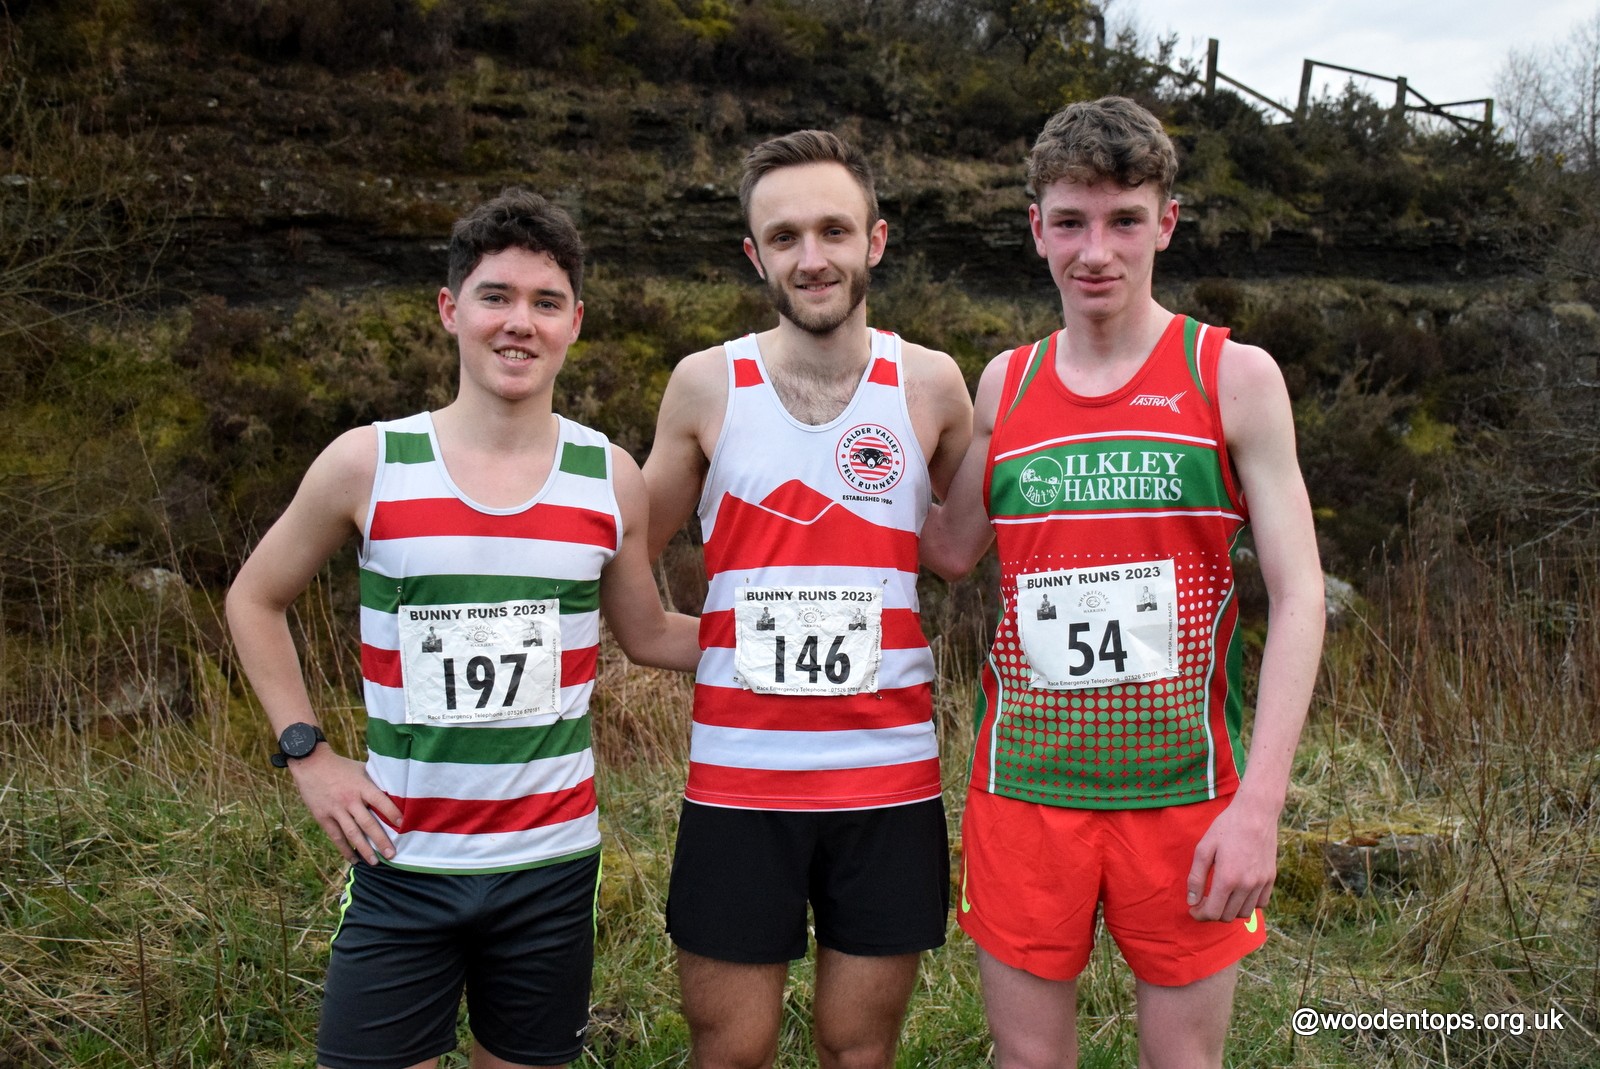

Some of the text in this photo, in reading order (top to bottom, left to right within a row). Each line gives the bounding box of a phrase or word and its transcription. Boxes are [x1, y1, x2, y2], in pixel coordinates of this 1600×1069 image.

[843, 427, 900, 454] CALDER VALLEY
[842, 464, 899, 490] FELL RUNNERS
[1064, 451, 1186, 477] ILKLEY
[842, 495, 880, 503] ESTABLISHED
[1063, 476, 1182, 502] HARRIERS
[1027, 566, 1161, 589] BUNNY RUNS 2023
[746, 591, 873, 602] BUNNY RUNS 2023
[409, 604, 546, 621] BUNNY RUNS 2023
[775, 635, 851, 685] 146
[1068, 619, 1128, 676] 54
[443, 653, 528, 710] 197
